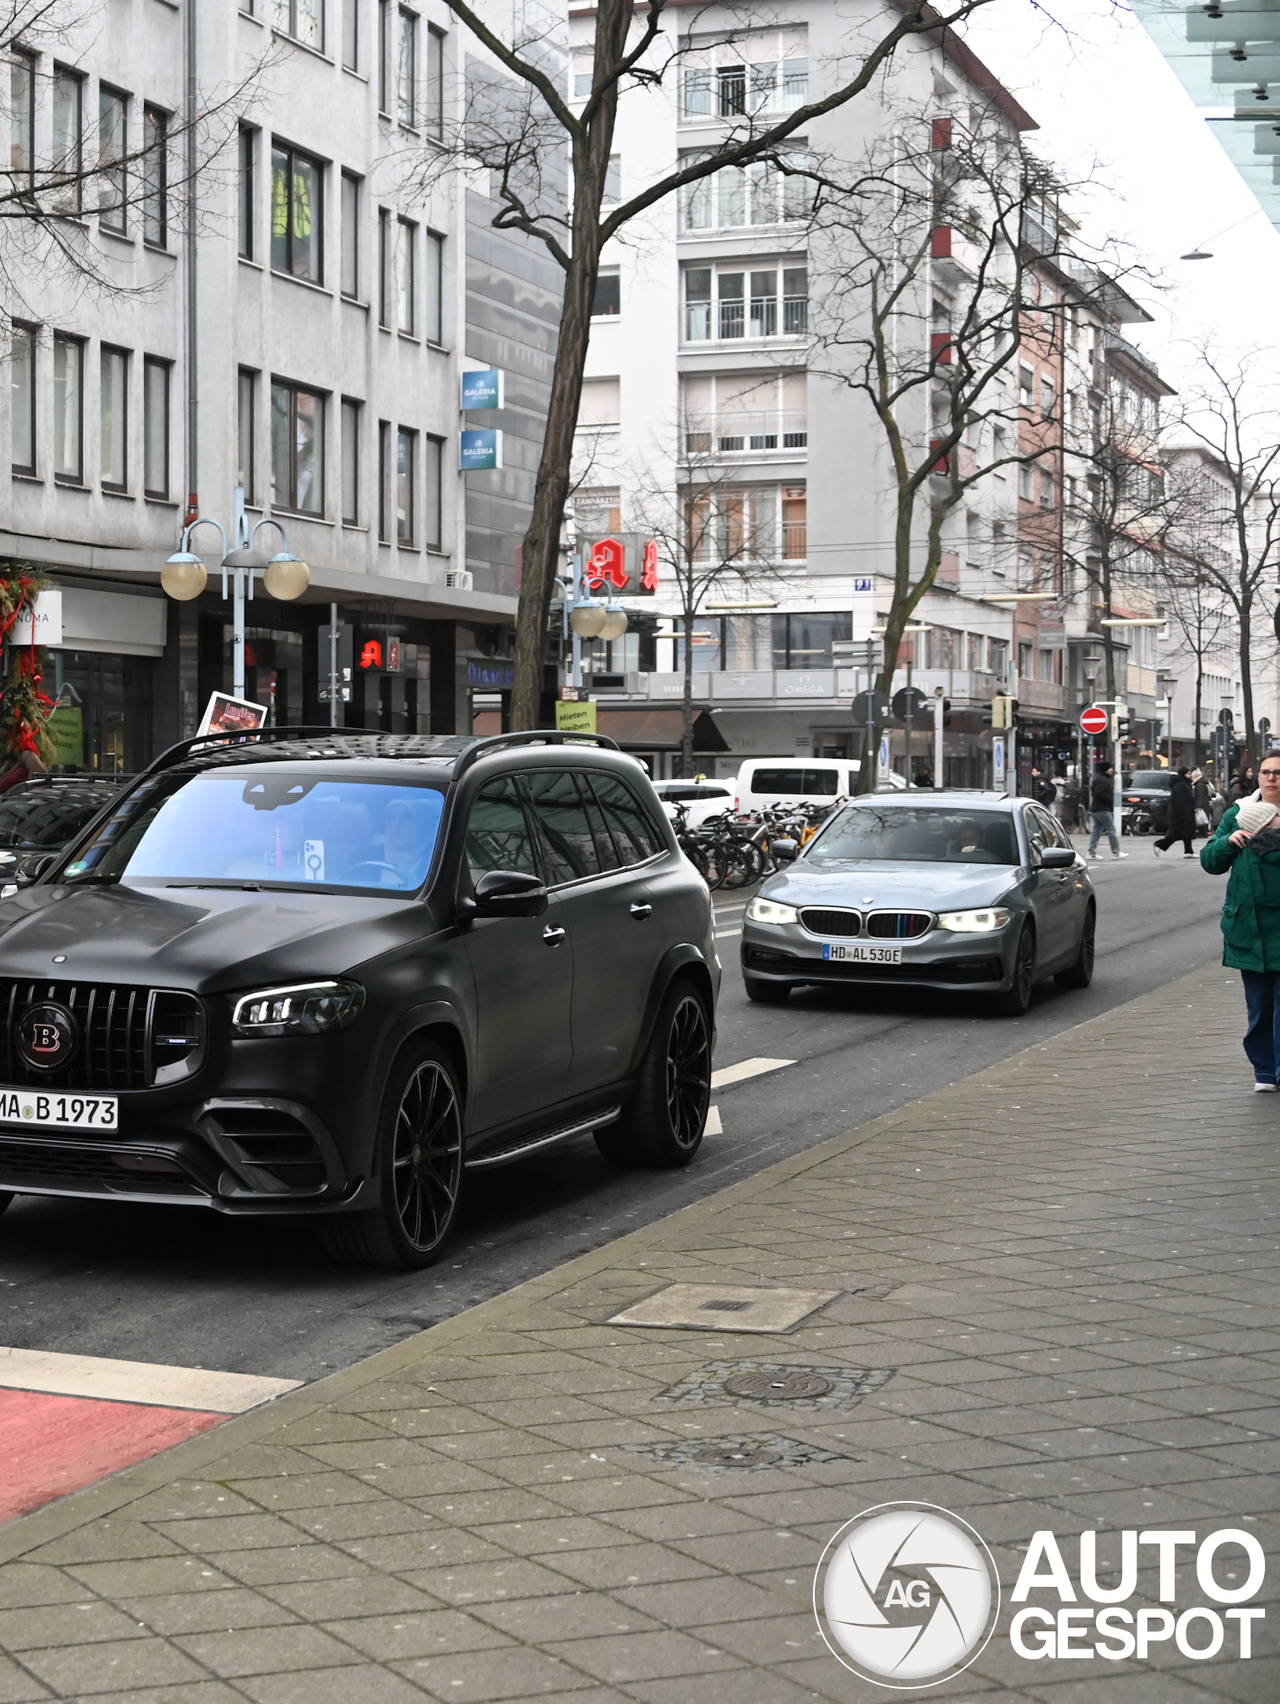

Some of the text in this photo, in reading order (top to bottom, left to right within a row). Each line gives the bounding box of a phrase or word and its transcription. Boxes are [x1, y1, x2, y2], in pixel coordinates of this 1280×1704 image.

[464, 388, 496, 397] GALERIA
[463, 447, 494, 456] GALERIA
[785, 685, 824, 694] OMEGA
[559, 711, 587, 722] Mieten
[831, 946, 900, 963] HD AL 530E
[32, 1023, 60, 1052] B
[36, 1096, 50, 1120] B
[56, 1097, 115, 1125] 1973
